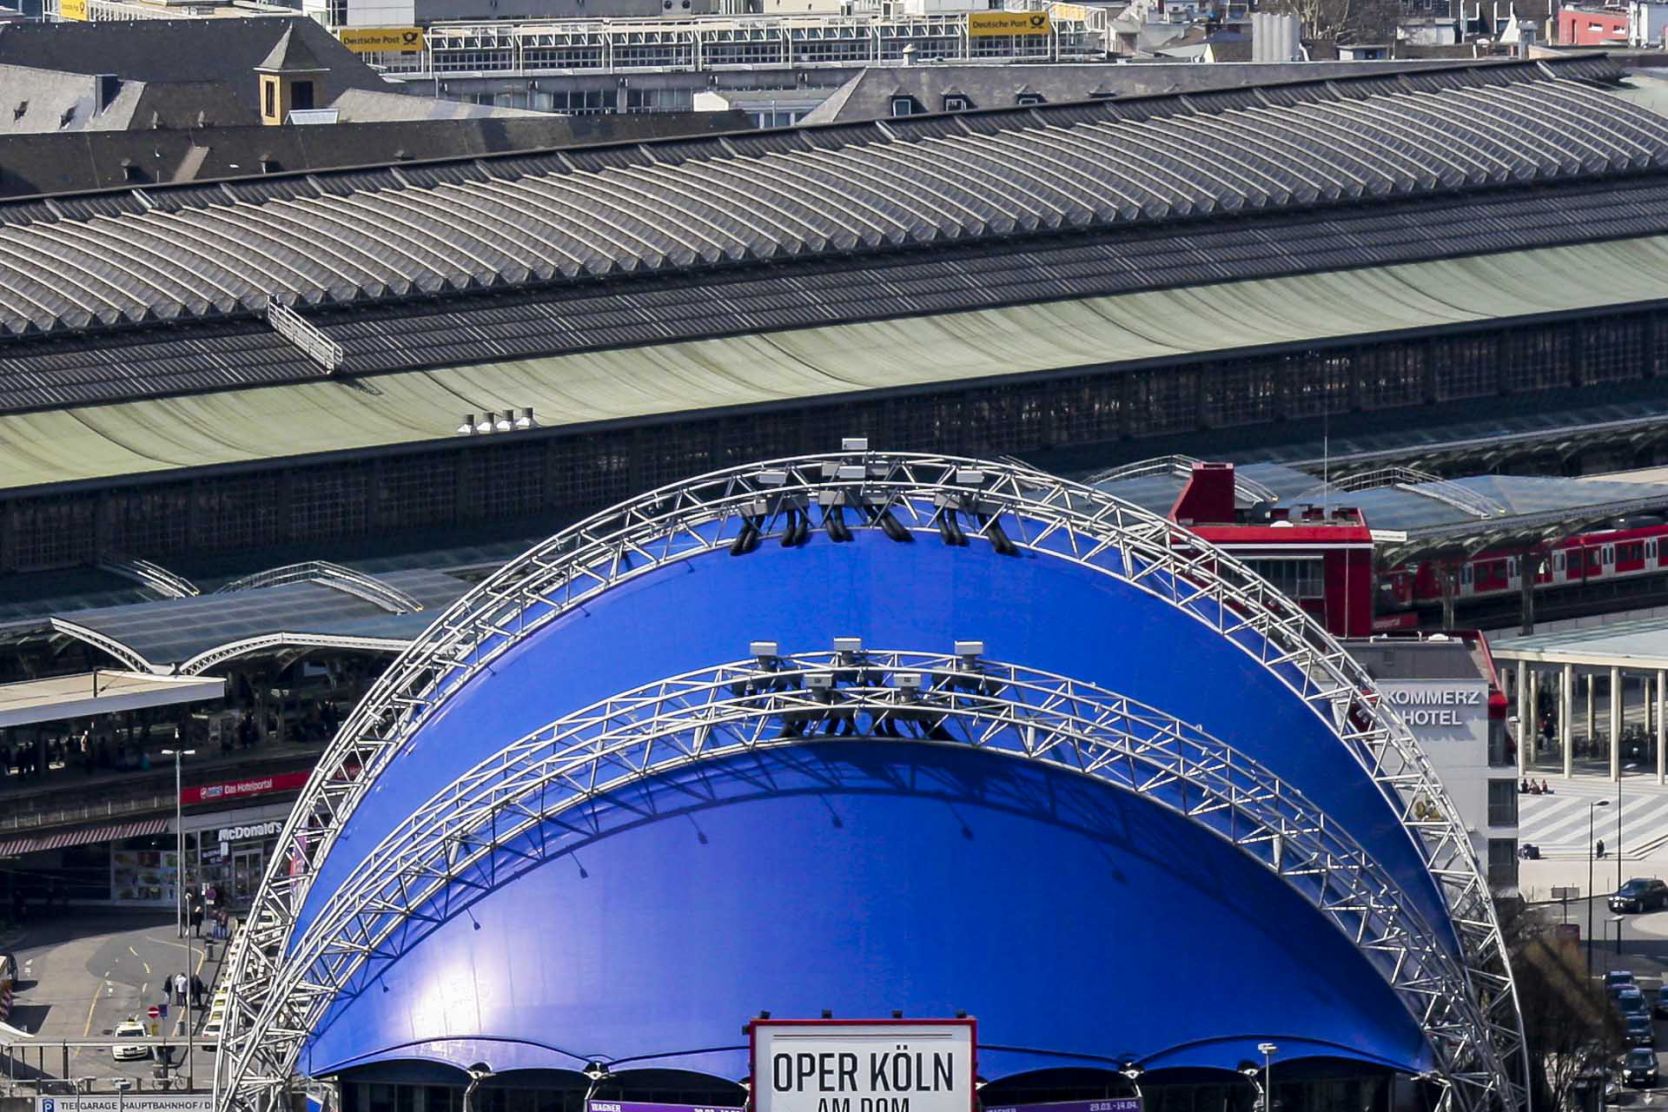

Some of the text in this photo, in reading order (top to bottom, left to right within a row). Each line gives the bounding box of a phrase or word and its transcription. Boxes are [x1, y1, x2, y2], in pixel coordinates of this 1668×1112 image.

[1387, 689, 1480, 705] KOMMERZ
[1402, 709, 1463, 725] HOTEL
[218, 821, 283, 842] McDonald's
[773, 1044, 954, 1092] OPER KÖLN
[122, 1101, 198, 1110] HAUPTBAHNHOF
[591, 1103, 622, 1112] WAGNER
